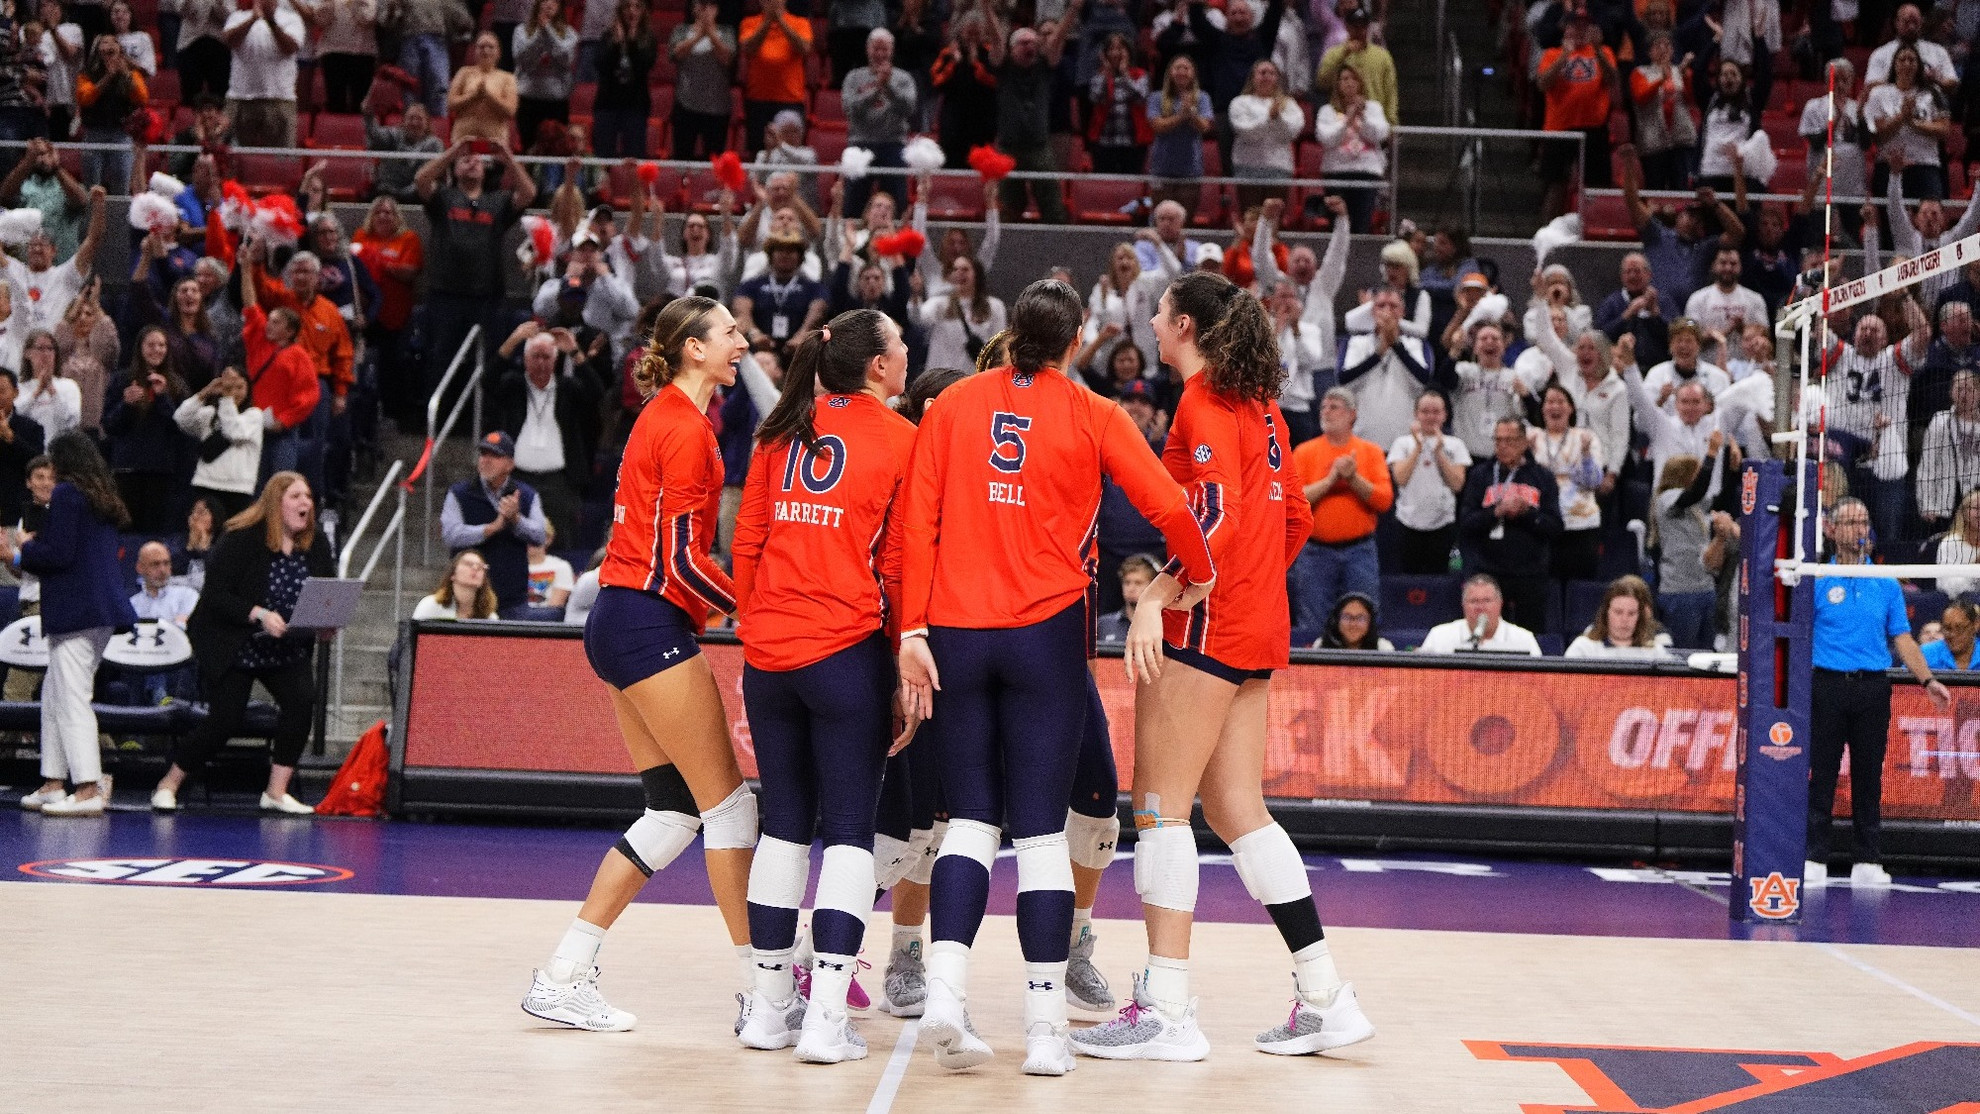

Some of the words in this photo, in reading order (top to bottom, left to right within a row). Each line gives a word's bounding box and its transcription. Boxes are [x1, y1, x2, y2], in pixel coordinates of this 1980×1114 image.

[1846, 369, 1882, 403] 34
[988, 411, 1033, 473] 5
[782, 432, 847, 494] 10
[988, 481, 1026, 507] BELL
[47, 858, 326, 883] SEC
